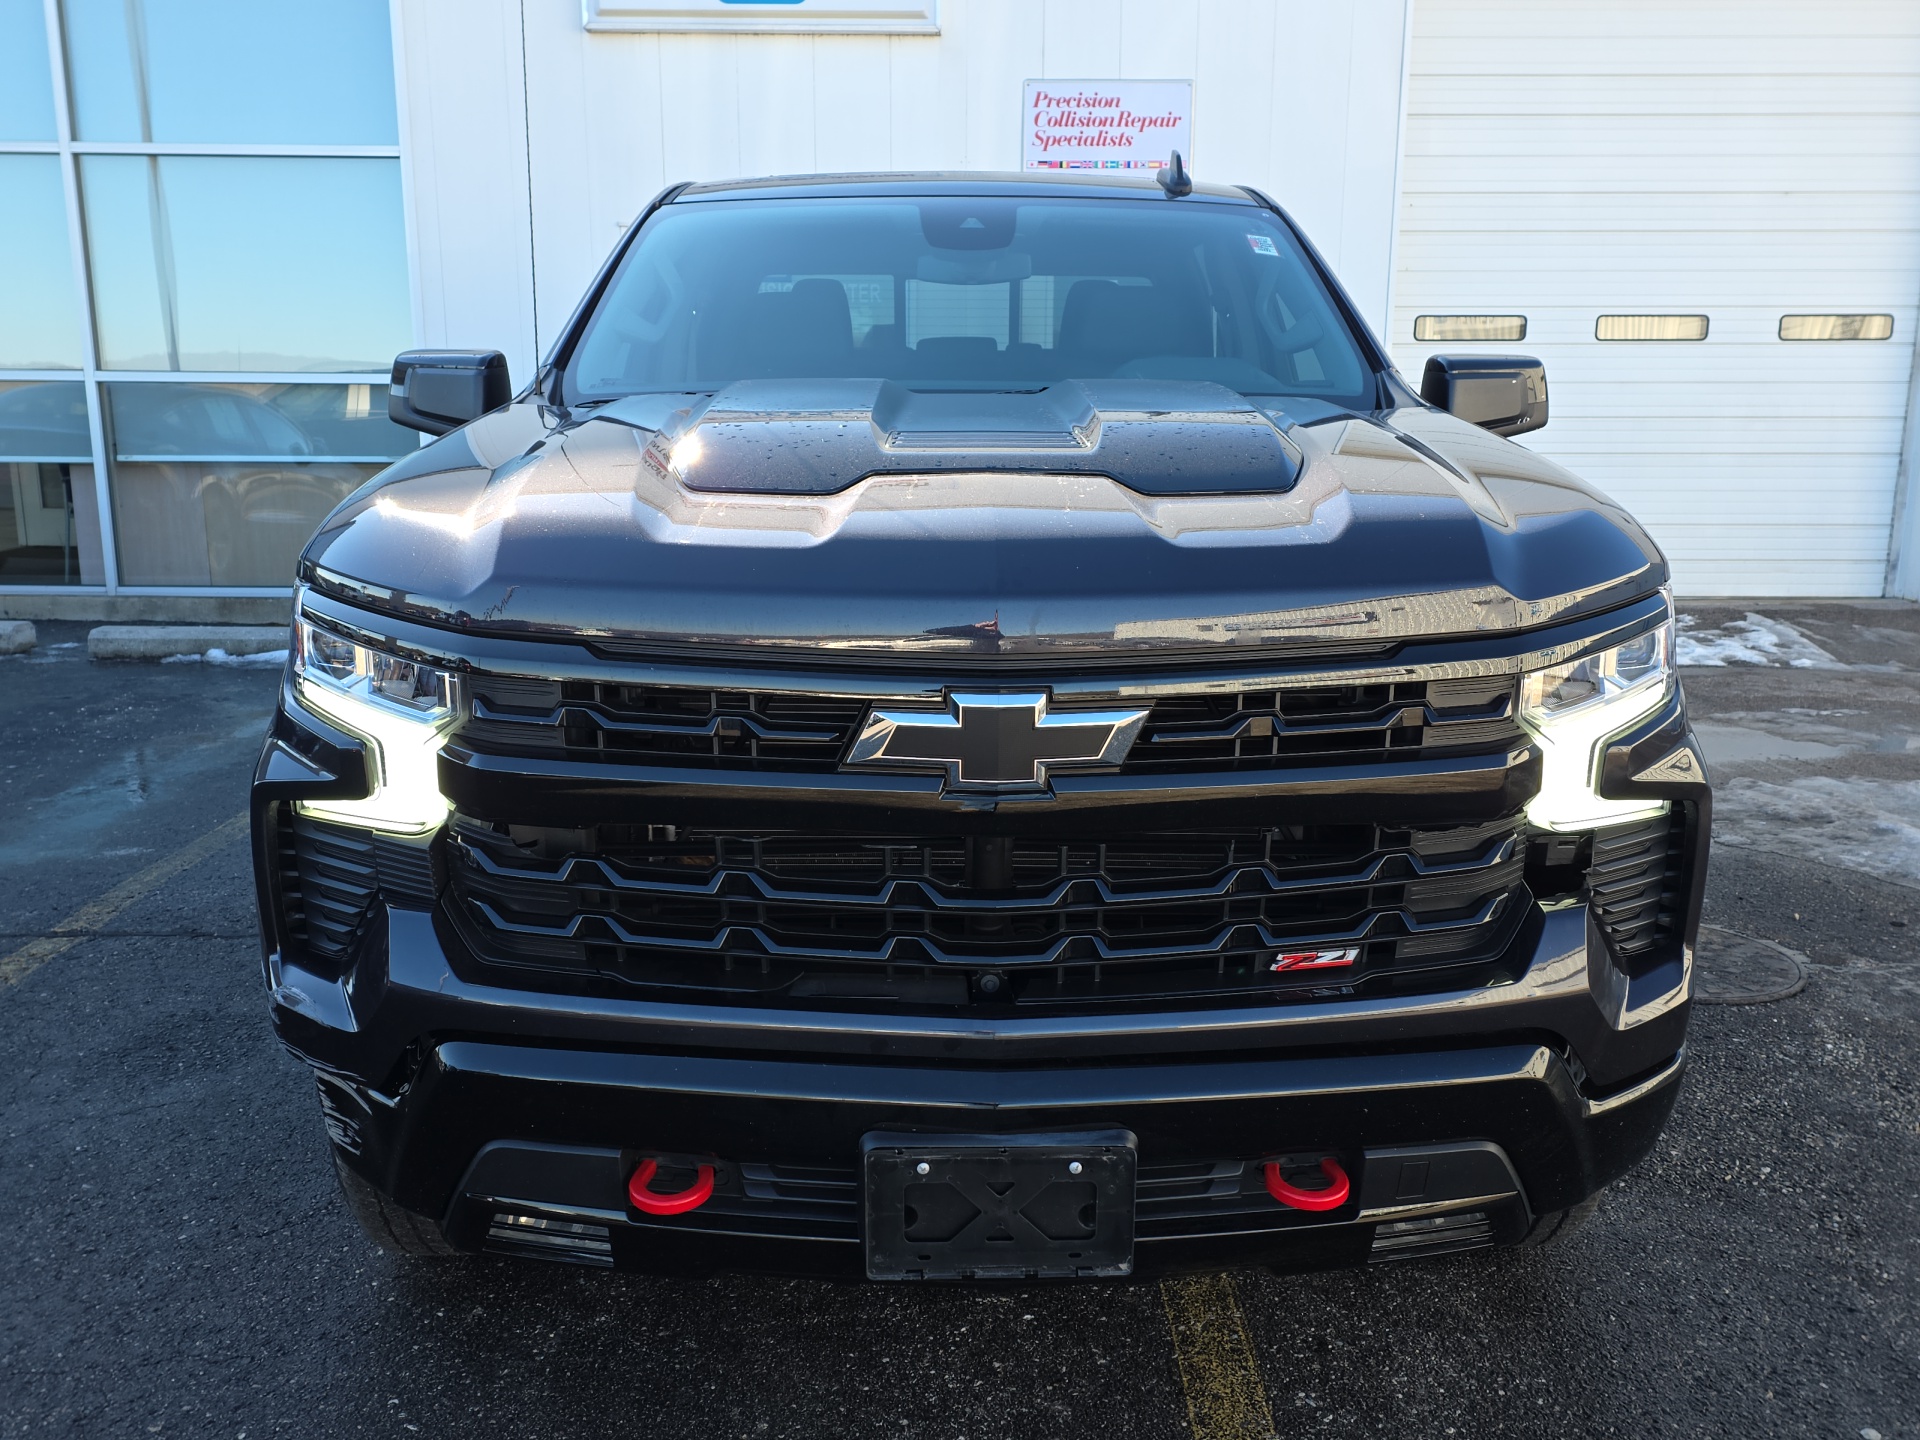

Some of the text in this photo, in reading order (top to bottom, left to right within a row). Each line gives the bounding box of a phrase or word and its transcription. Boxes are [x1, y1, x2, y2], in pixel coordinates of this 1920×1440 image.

[1032, 90, 1121, 109] Precision
[1033, 110, 1182, 133] Collision Repair
[1032, 129, 1134, 152] Specialists
[1269, 948, 1360, 972] Z71
